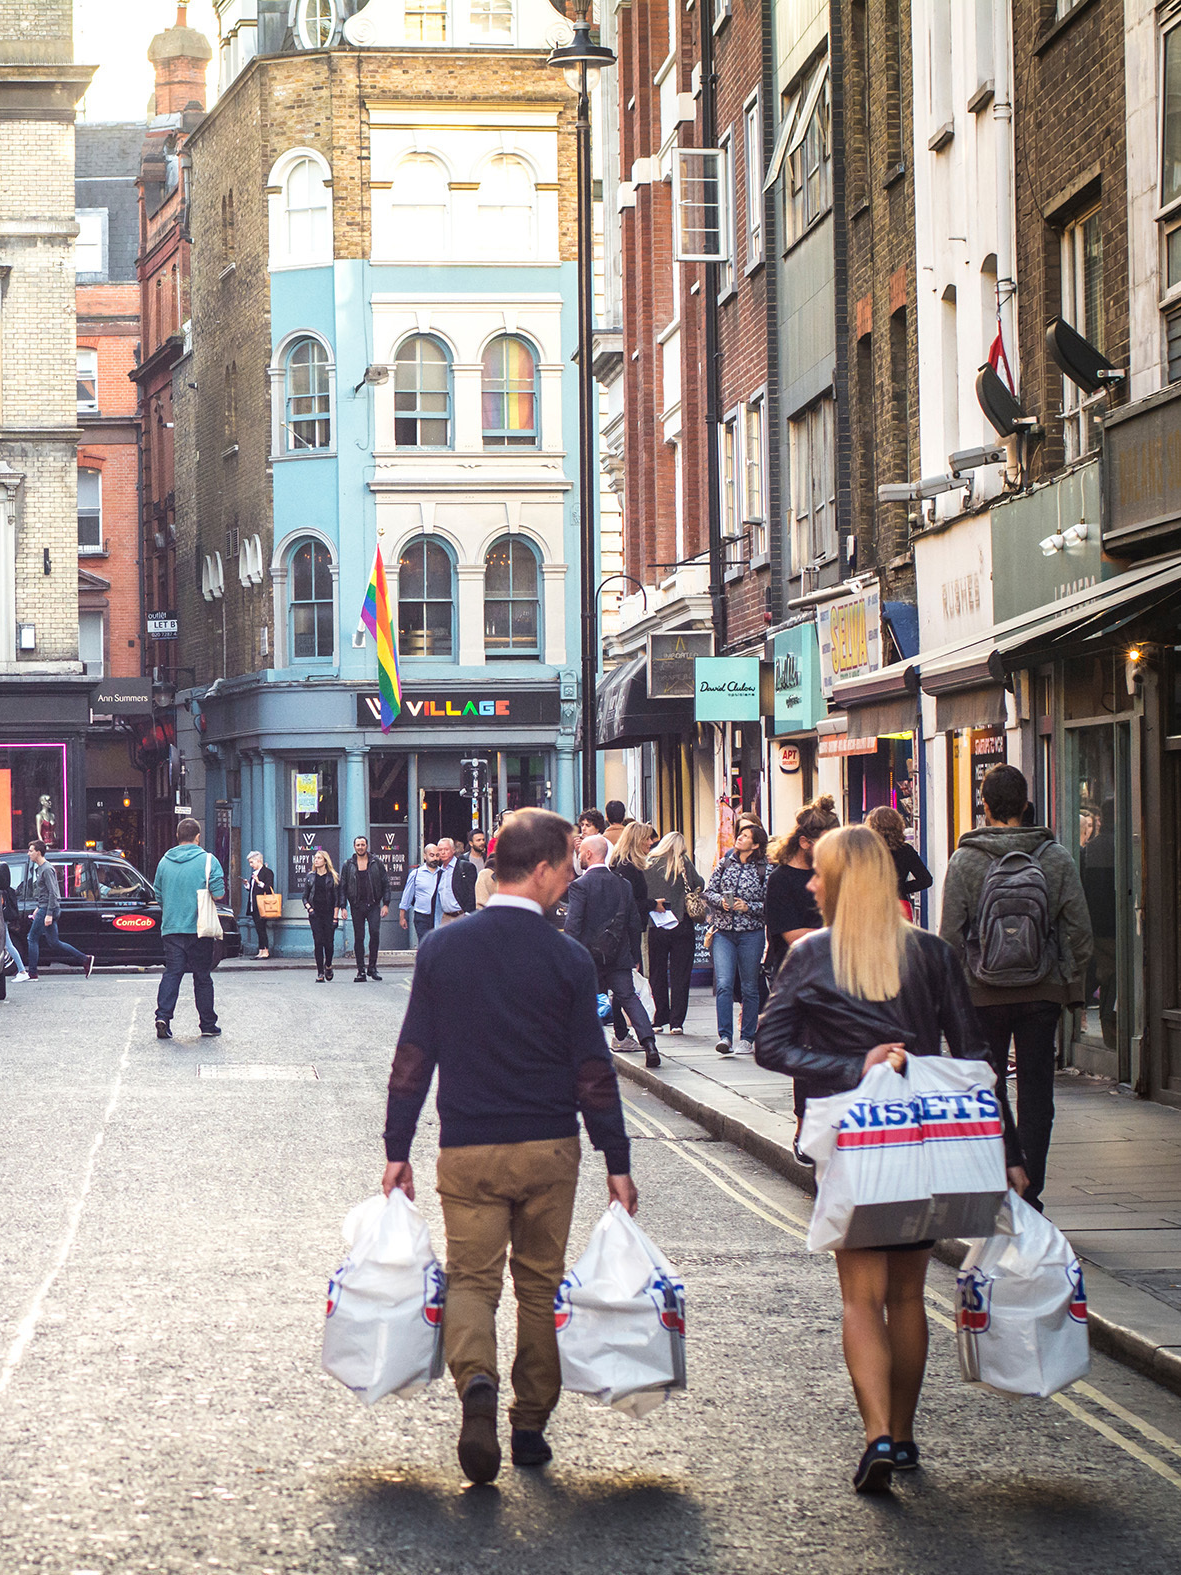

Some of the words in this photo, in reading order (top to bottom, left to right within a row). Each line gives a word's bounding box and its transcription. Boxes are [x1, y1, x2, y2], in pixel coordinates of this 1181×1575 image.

[154, 621, 168, 629] LET
[699, 681, 726, 693] David
[727, 681, 756, 693] Clulow
[97, 694, 113, 702] Ann
[114, 694, 149, 702] Summers
[405, 700, 510, 717] VILLAGE
[782, 750, 798, 760] APT
[292, 855, 310, 864] HAPPY
[116, 918, 152, 927] ComCab
